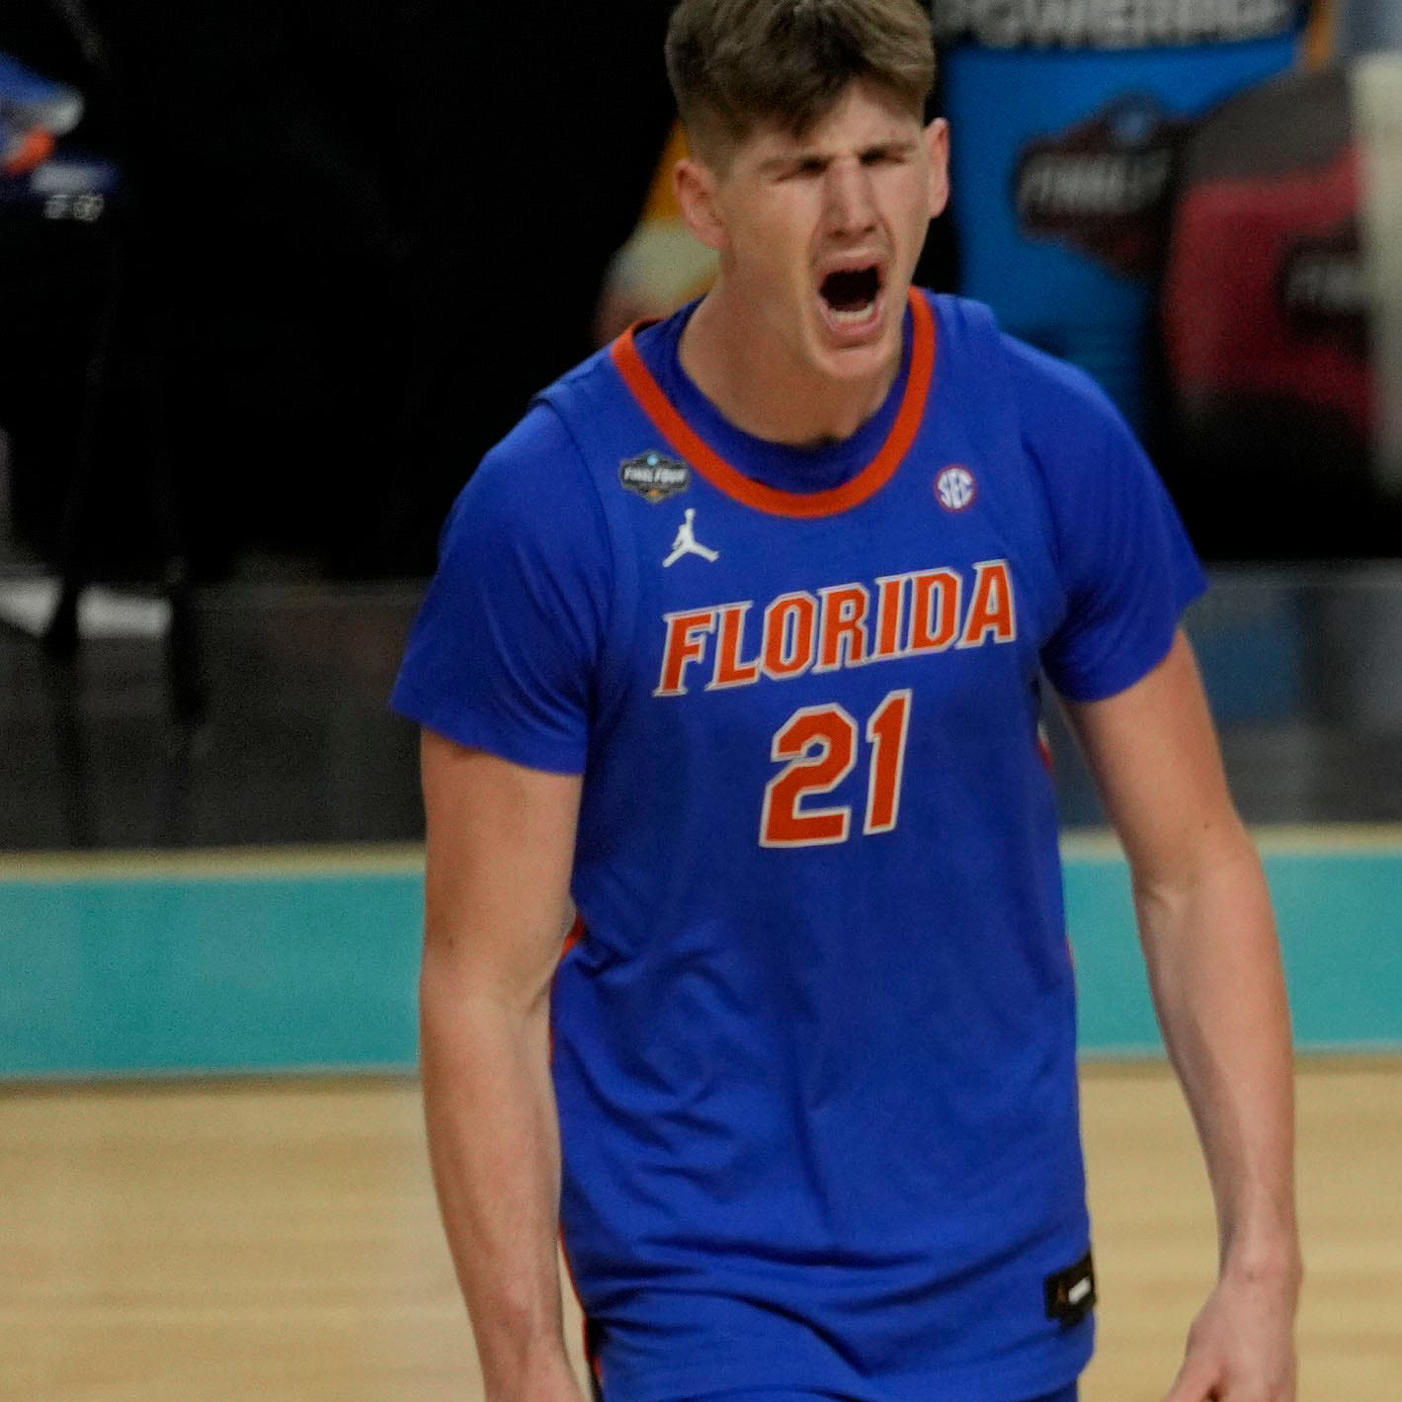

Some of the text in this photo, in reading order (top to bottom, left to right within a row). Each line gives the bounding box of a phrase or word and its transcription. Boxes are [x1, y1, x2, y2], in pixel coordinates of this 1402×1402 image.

[937, 468, 973, 509] SEC
[653, 558, 1017, 697] FLORIDA
[758, 689, 913, 849] 21
